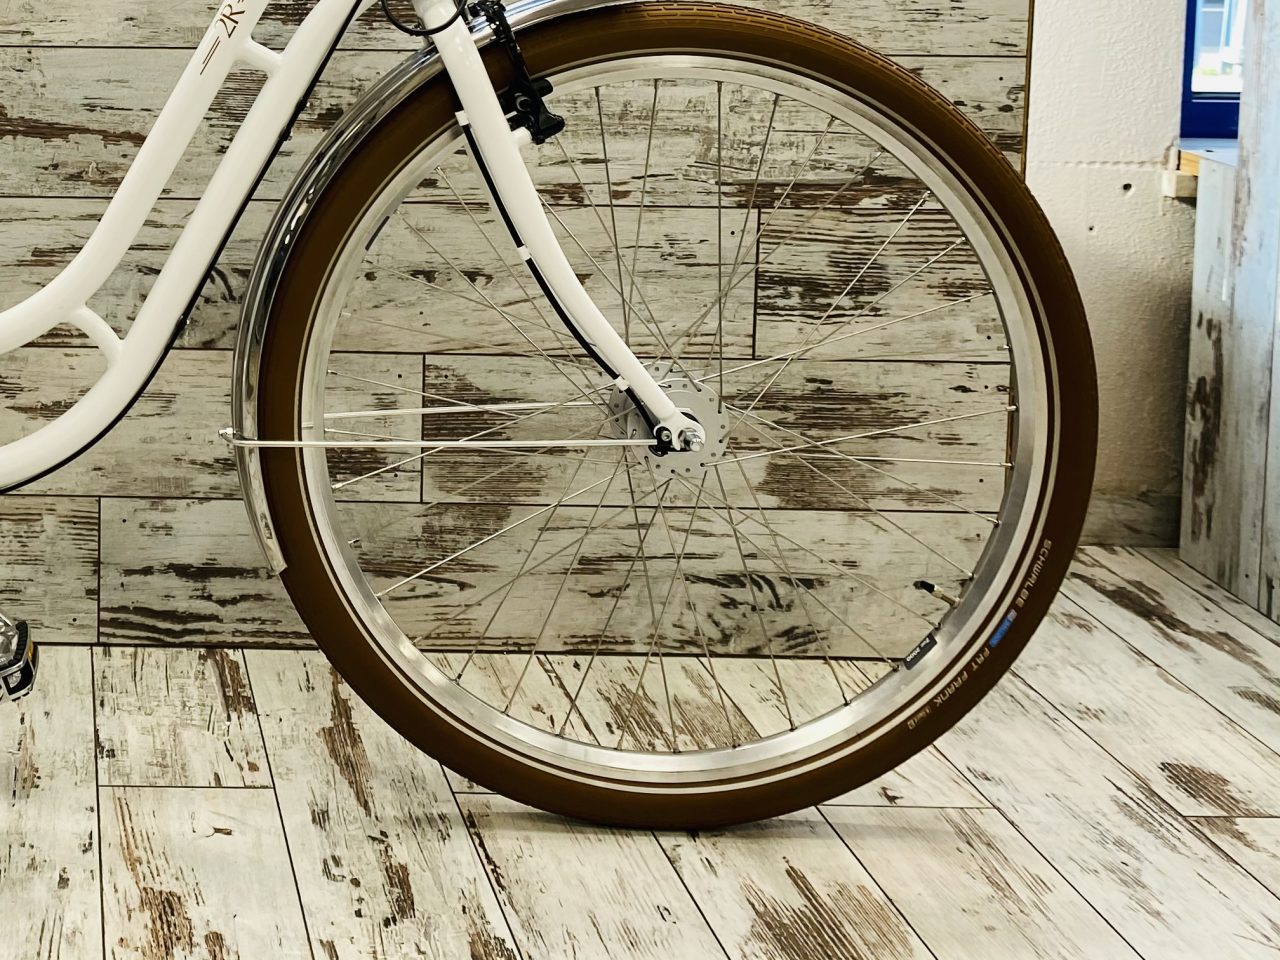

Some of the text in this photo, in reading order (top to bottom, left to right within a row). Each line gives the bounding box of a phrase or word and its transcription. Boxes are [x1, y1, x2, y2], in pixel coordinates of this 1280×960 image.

[215, 4, 245, 39] 2R
[933, 539, 1052, 707] SCHWALBE FAT FRANK
